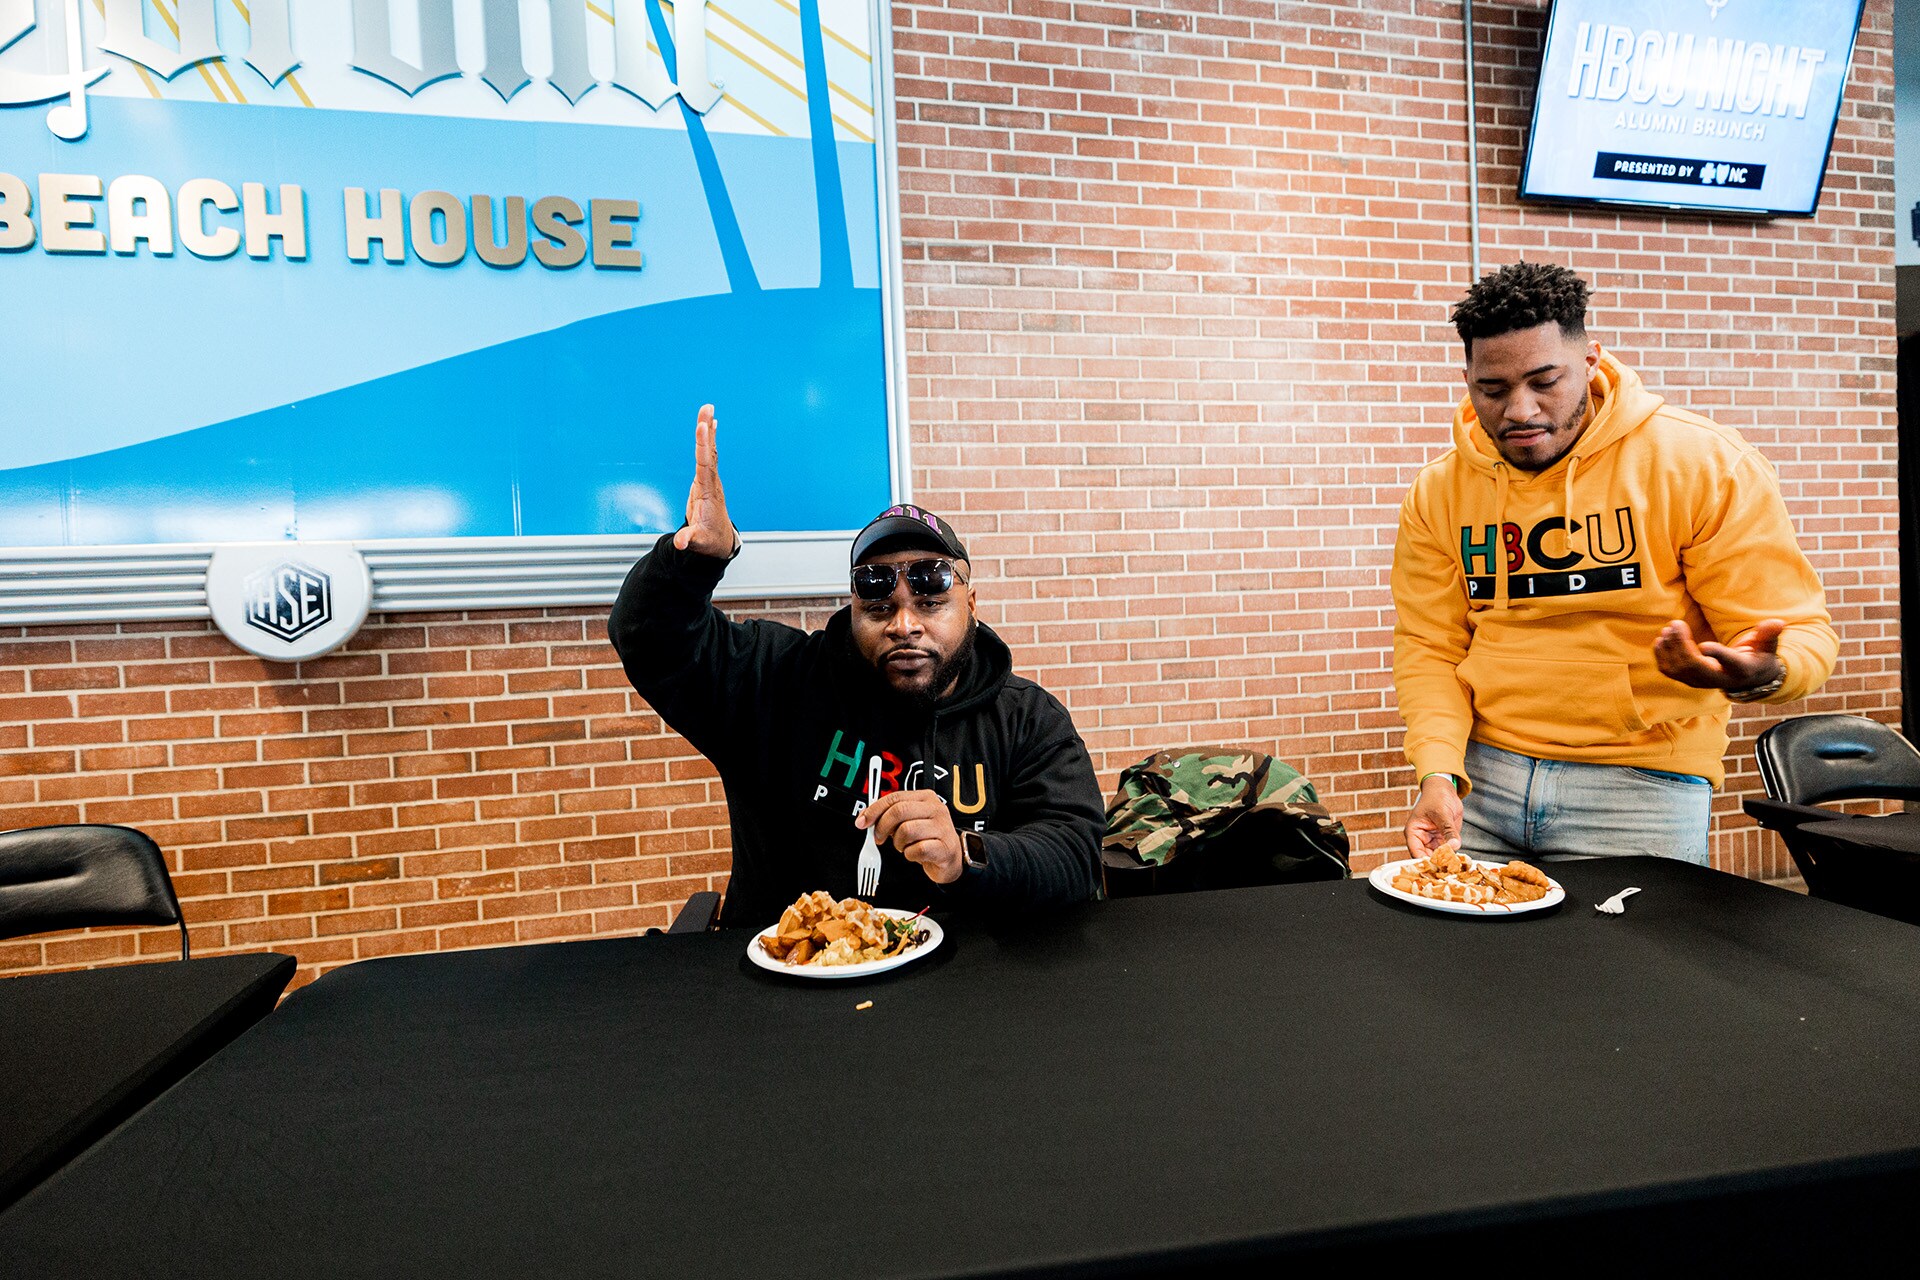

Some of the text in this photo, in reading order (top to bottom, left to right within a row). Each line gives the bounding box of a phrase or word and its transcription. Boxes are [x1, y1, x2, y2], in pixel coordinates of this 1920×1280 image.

[1567, 21, 1826, 119] HBCU NIGHT
[1614, 111, 1766, 141] ALUMNI BRUNCH
[1614, 160, 1748, 183] PRESENTED BY NC
[343, 186, 643, 272] HOUSE
[1460, 506, 1637, 576] HBCU
[1469, 567, 1636, 596] PIDE
